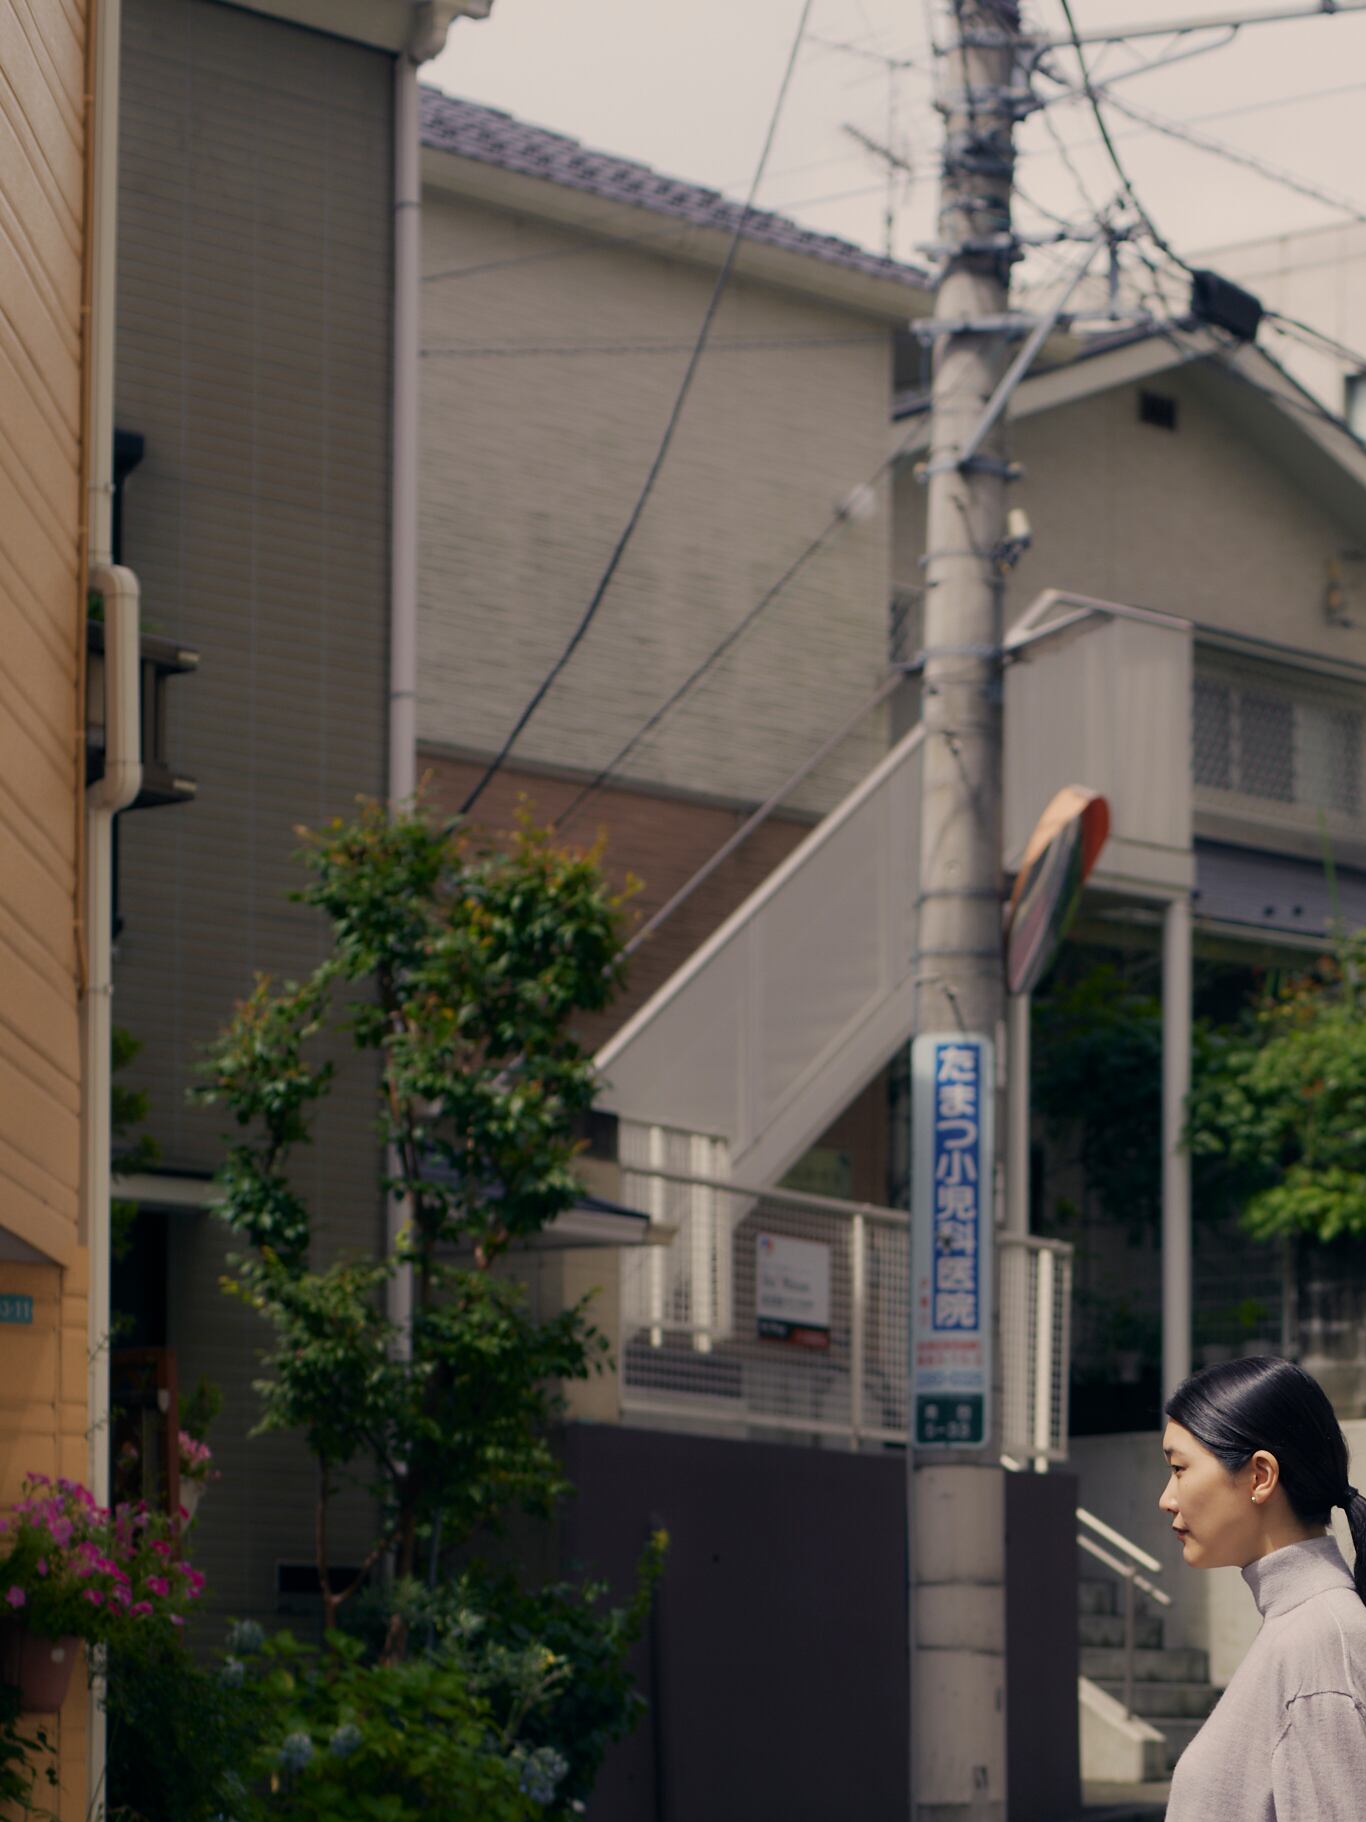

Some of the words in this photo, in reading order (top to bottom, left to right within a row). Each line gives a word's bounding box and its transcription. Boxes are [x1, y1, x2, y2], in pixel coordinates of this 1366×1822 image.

[937, 1046, 977, 1327] たまつ小児科医院
